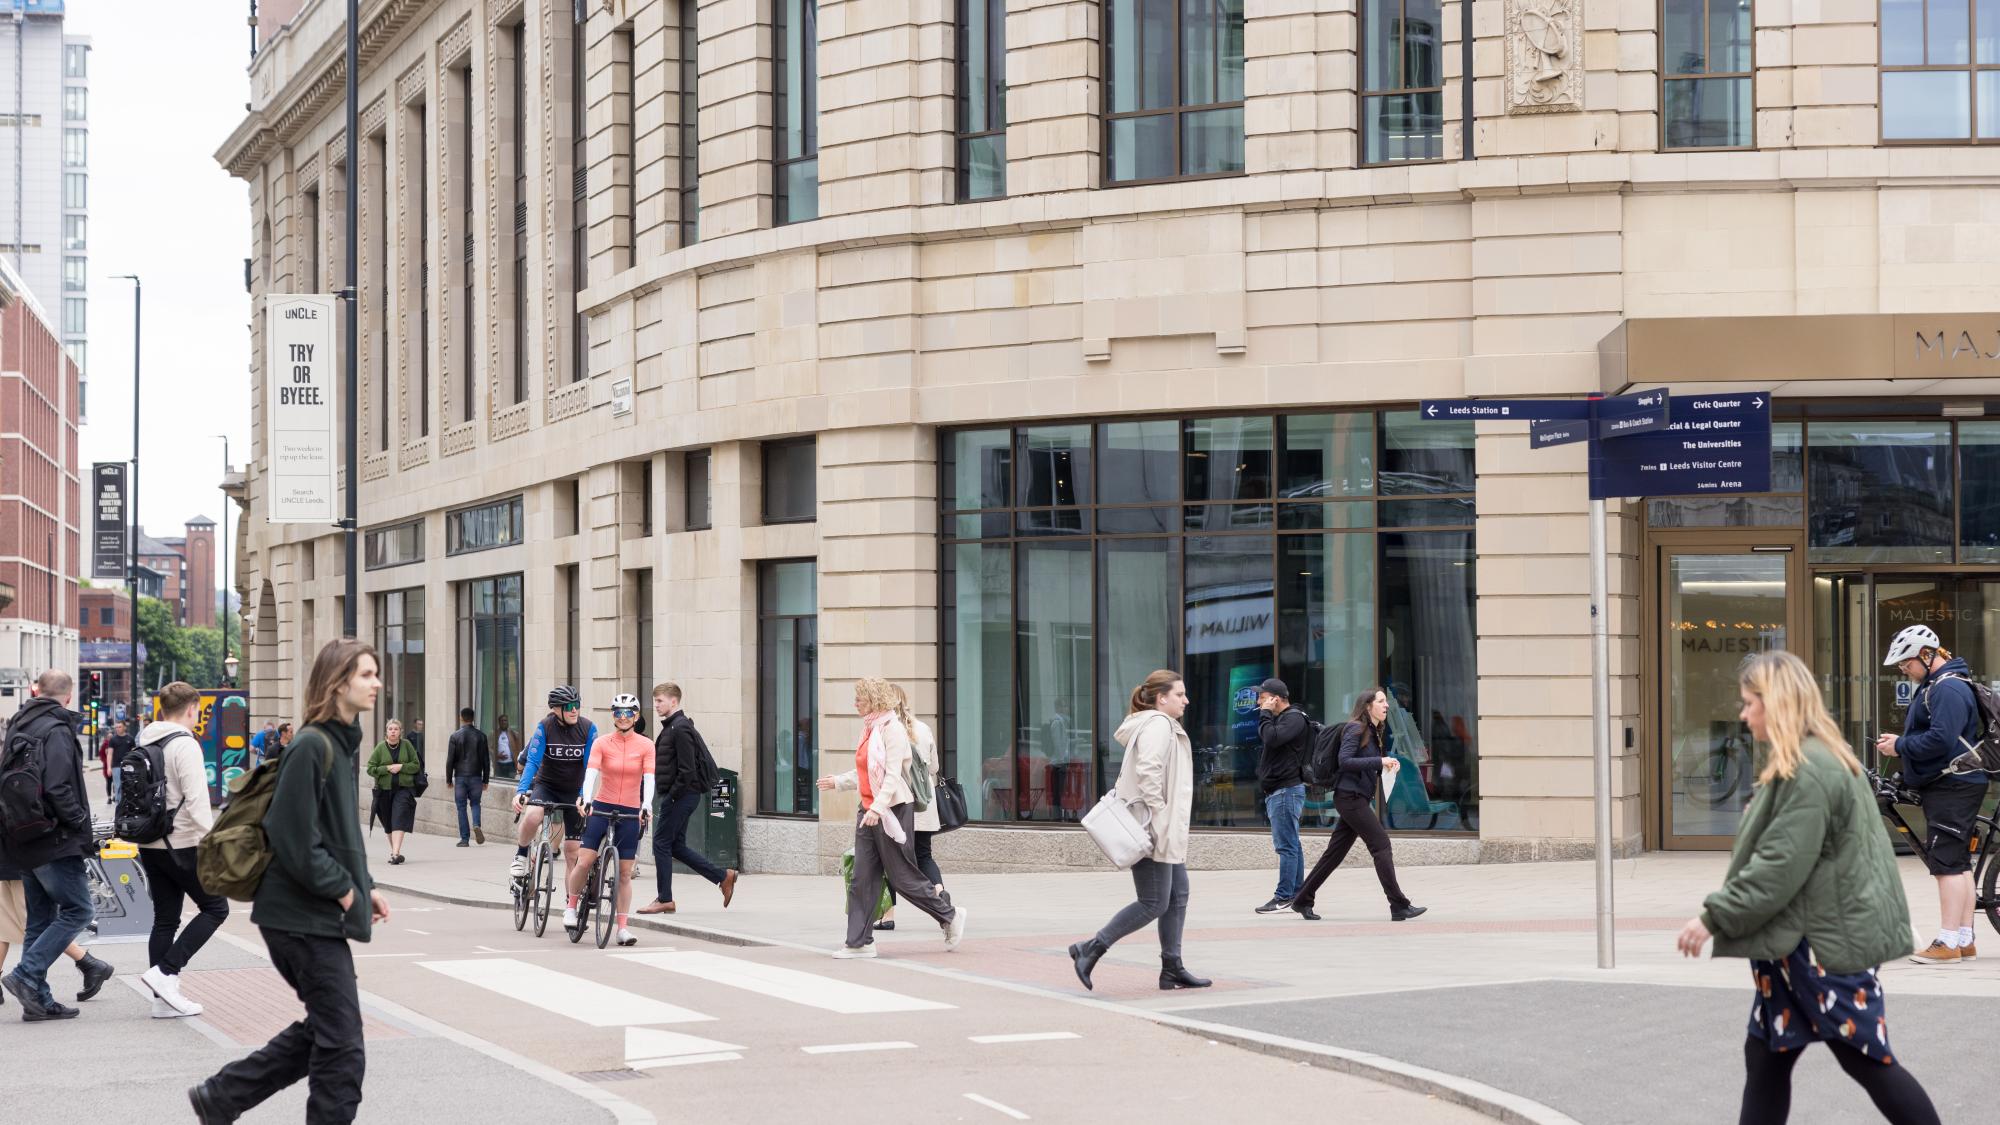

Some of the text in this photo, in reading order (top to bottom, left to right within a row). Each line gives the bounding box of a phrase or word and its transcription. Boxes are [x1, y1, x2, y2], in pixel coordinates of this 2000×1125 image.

[285, 307, 318, 319] UNCLE
[1914, 329, 2000, 361] MAJ
[289, 343, 315, 362] TRY
[293, 365, 311, 384] OR
[280, 386, 324, 405] BYEEE.
[1449, 406, 1499, 414] Leeds Station
[1693, 400, 1741, 409] Civic Quarter
[1685, 421, 1690, 430] &
[1692, 420, 1711, 431] Legal
[1713, 420, 1741, 429] Quarter
[1683, 439, 1742, 449] The Universities
[1669, 462, 1690, 470] Leeds
[1692, 461, 1716, 469] Visitor
[1718, 460, 1742, 468] Centre
[1720, 480, 1742, 488] Arena
[1890, 608, 1973, 621] MAJESTIC
[1681, 637, 1786, 653] MAJESTI
[549, 747, 563, 757] LE
